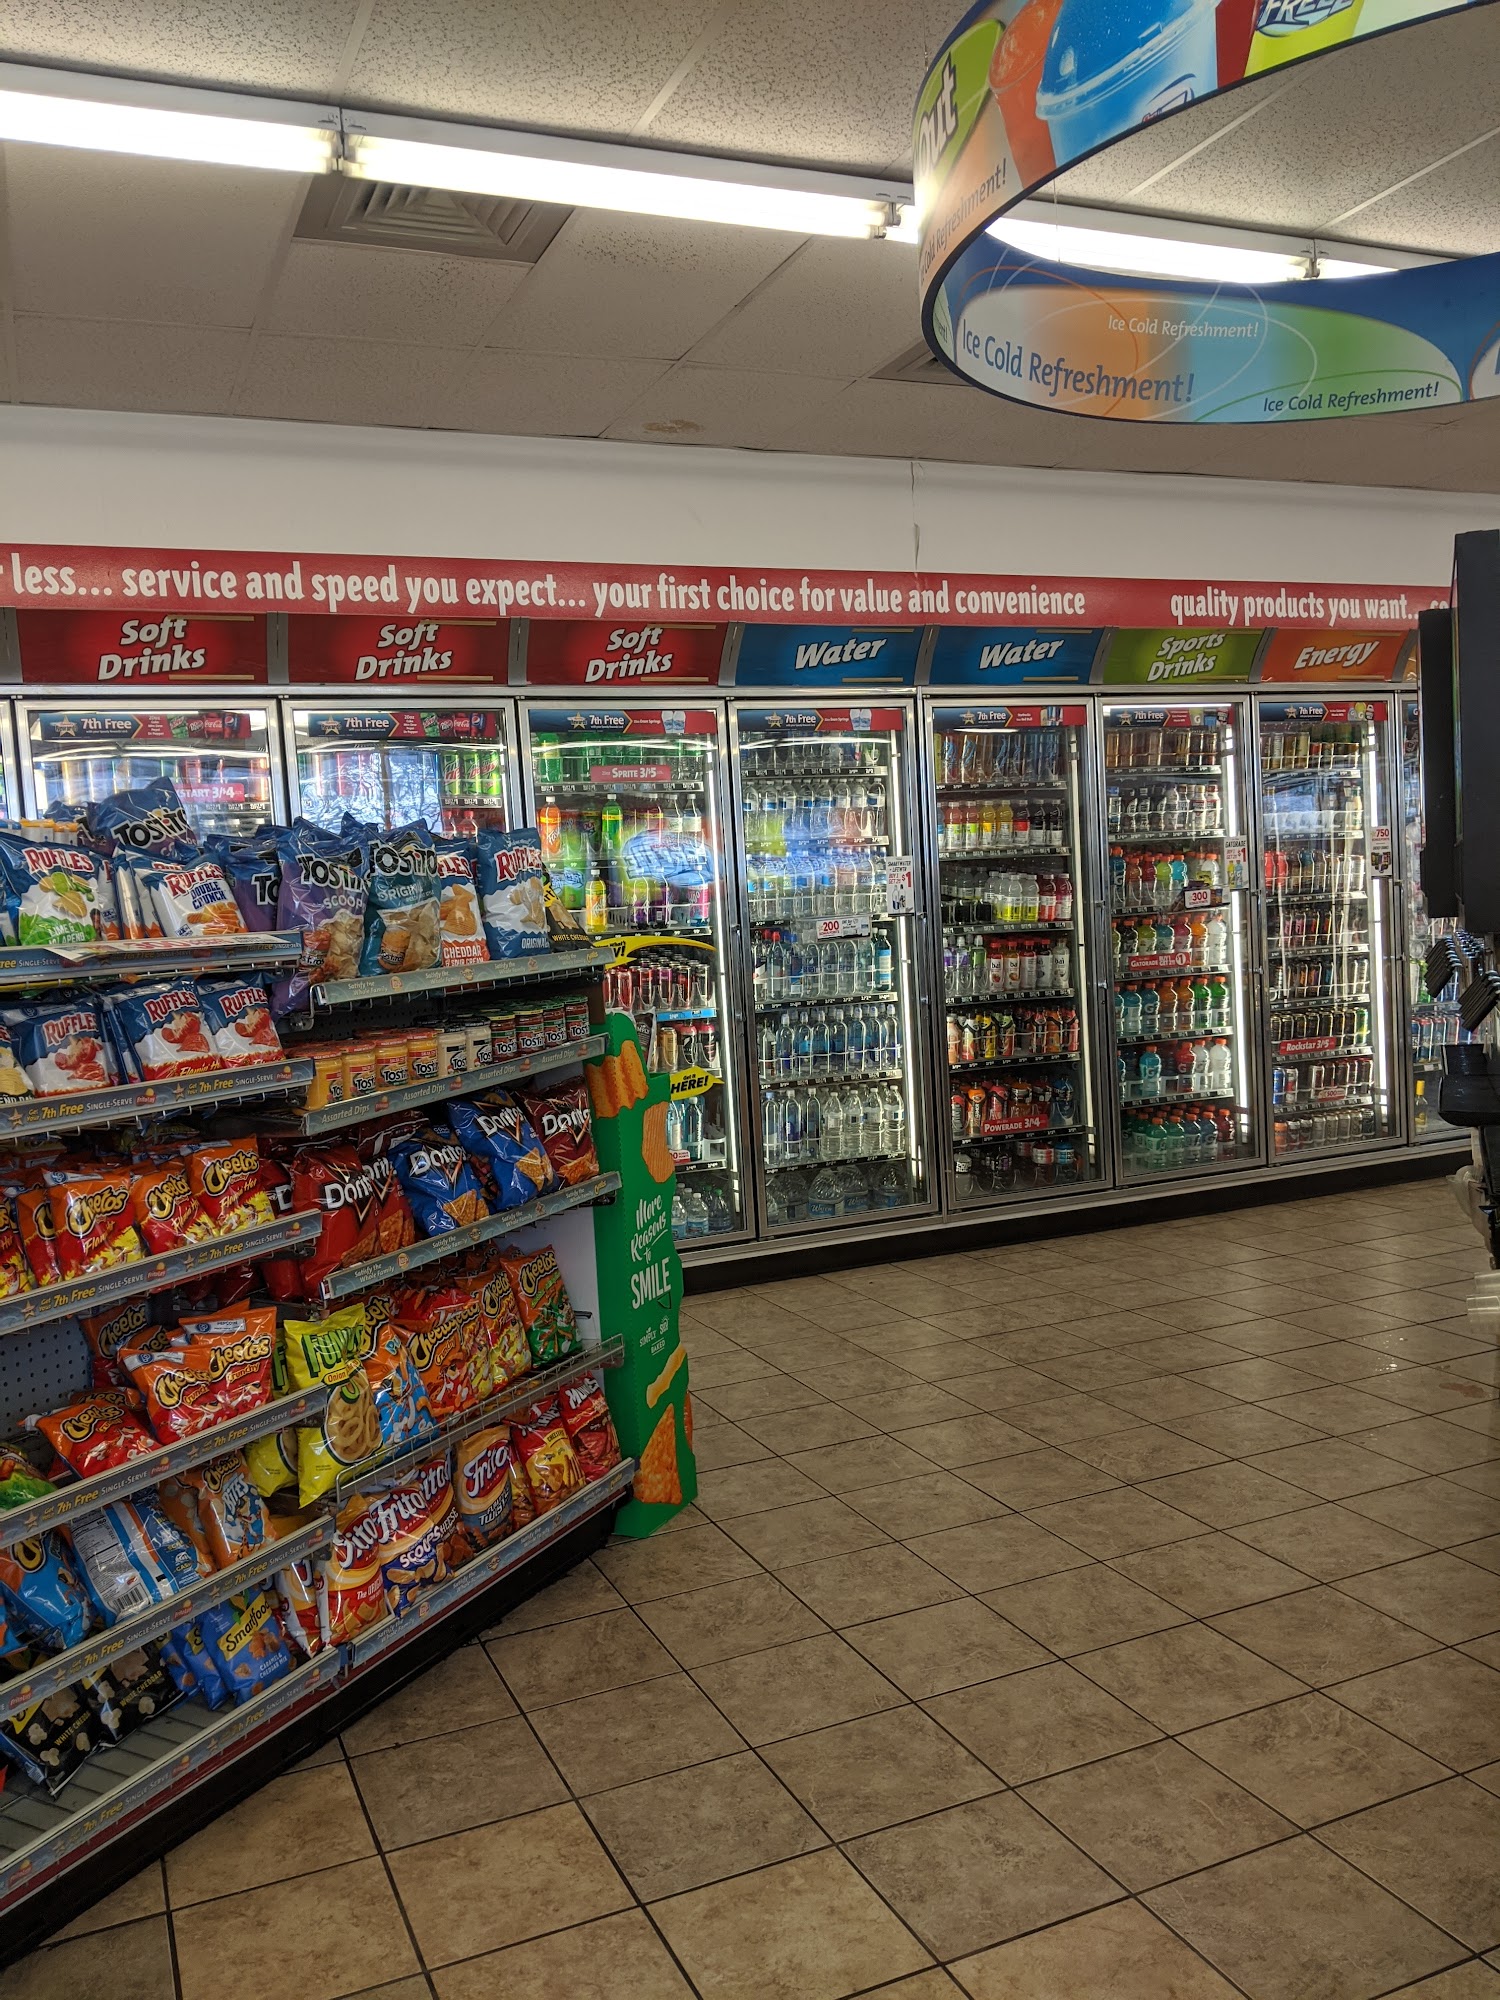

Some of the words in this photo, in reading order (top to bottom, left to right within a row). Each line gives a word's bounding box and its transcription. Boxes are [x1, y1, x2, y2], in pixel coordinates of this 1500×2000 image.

[1108, 314, 1126, 332] Ice
[1129, 317, 1159, 335] Cold
[1162, 320, 1259, 342] Refreshment!
[962, 319, 981, 360] Ice
[985, 335, 1024, 379] Cold
[1028, 351, 1195, 403] Refreshment!
[1263, 397, 1285, 412] Ice
[1288, 393, 1324, 412] Cold
[1327, 380, 1440, 412] Refreshment!
[122, 561, 238, 599] service
[246, 561, 303, 601] and
[311, 565, 398, 613] speed
[405, 576, 458, 614] you
[593, 580, 652, 618] your
[656, 572, 711, 611] first
[716, 576, 795, 613] choice
[799, 576, 835, 612] for
[840, 578, 902, 613] value
[908, 580, 949, 615] and
[954, 584, 1086, 616] convenience
[1170, 586, 1239, 625] quality
[1243, 587, 1327, 626] products
[1328, 598, 1361, 627] you
[119, 617, 189, 648] Soft
[376, 621, 441, 650] Soft
[606, 625, 664, 653] Soft
[1159, 633, 1226, 661] Sports
[97, 643, 206, 681] Drinks
[354, 648, 453, 681] Drinks
[584, 649, 673, 684] Drinks
[794, 636, 888, 671] Water
[978, 635, 1065, 671] Water
[1146, 651, 1219, 682] Drinks
[1294, 638, 1380, 671] Energy
[81, 718, 102, 730] 7th
[104, 718, 132, 730] Free
[344, 717, 363, 728] 7th
[365, 717, 389, 728] Free
[589, 715, 602, 725] 7th
[604, 715, 625, 725] Free
[785, 714, 796, 724] 7th
[798, 714, 816, 724] Free
[977, 711, 988, 720] 7th
[989, 711, 1006, 720] Free
[1133, 710, 1145, 720] 7th
[1146, 710, 1164, 720] Free
[1299, 706, 1308, 715] 7th
[1309, 706, 1323, 715] Free
[612, 768, 638, 778] SPRITE
[22, 847, 95, 873] RUFFLES
[496, 846, 542, 882] RUFFLES
[164, 862, 225, 898] RUFFLES
[190, 881, 221, 901] DOUBLE
[192, 890, 227, 910] CRUNCH
[1192, 891, 1208, 901] 300
[823, 921, 840, 931] 200
[443, 945, 482, 959] CHEDDAR
[145, 989, 199, 1024] RUFFLES
[219, 987, 269, 1017] RUFFLES
[42, 1012, 98, 1047] RUFFLES
[1286, 1042, 1316, 1052] Rockstar
[199, 1081, 212, 1093] 7th
[214, 1077, 233, 1091] Free
[235, 1072, 274, 1086] SINGLE-SERVE
[479, 1070, 503, 1081] Assorted
[504, 1065, 516, 1075] Dips
[671, 1075, 709, 1094] HERE!
[41, 1107, 57, 1119] 7th
[59, 1103, 84, 1116] Free
[86, 1097, 133, 1111] SINGLE-SERVE
[403, 1086, 431, 1102] Assorted
[431, 1083, 446, 1094] Dips
[322, 1108, 353, 1124] Assorted
[354, 1104, 370, 1115] Dips
[984, 1122, 1023, 1133] POWERADE
[202, 1150, 259, 1196] Cheetos
[66, 1185, 128, 1236] Cheetos
[636, 1195, 662, 1230] More
[210, 1248, 222, 1260] 7th
[223, 1241, 243, 1256] Free
[245, 1231, 283, 1250] SINGLE-SERVE
[631, 1211, 667, 1262] Reasons
[519, 1252, 556, 1297] Cheetos
[631, 1257, 672, 1309] SMILE
[53, 1295, 69, 1309] 7th
[71, 1286, 96, 1304] Free
[98, 1273, 144, 1294] SINGLE-SERVE
[208, 1334, 272, 1383] Cheetos
[213, 1434, 226, 1448] 7th
[228, 1425, 248, 1442] Free
[249, 1410, 288, 1432] SINGLE-SERVE
[464, 1445, 508, 1498] Frito
[57, 1499, 72, 1514] 7th
[75, 1490, 99, 1508] Free
[101, 1471, 148, 1494] SINGLE-SERVE
[371, 1490, 427, 1545] Frito
[235, 1572, 247, 1585] 7th
[248, 1561, 268, 1578] Free
[269, 1542, 306, 1566] SINGLE-SERVE
[84, 1652, 98, 1667] 7th
[101, 1638, 125, 1658] Free
[126, 1613, 172, 1644] SINGLE-SERVE
[225, 1600, 270, 1652] Smartfood
[119, 1687, 138, 1708] WHITE
[136, 1670, 163, 1693] CHEDDAR
[53, 1726, 74, 1746] WHITE
[99, 1800, 124, 1823] Free
